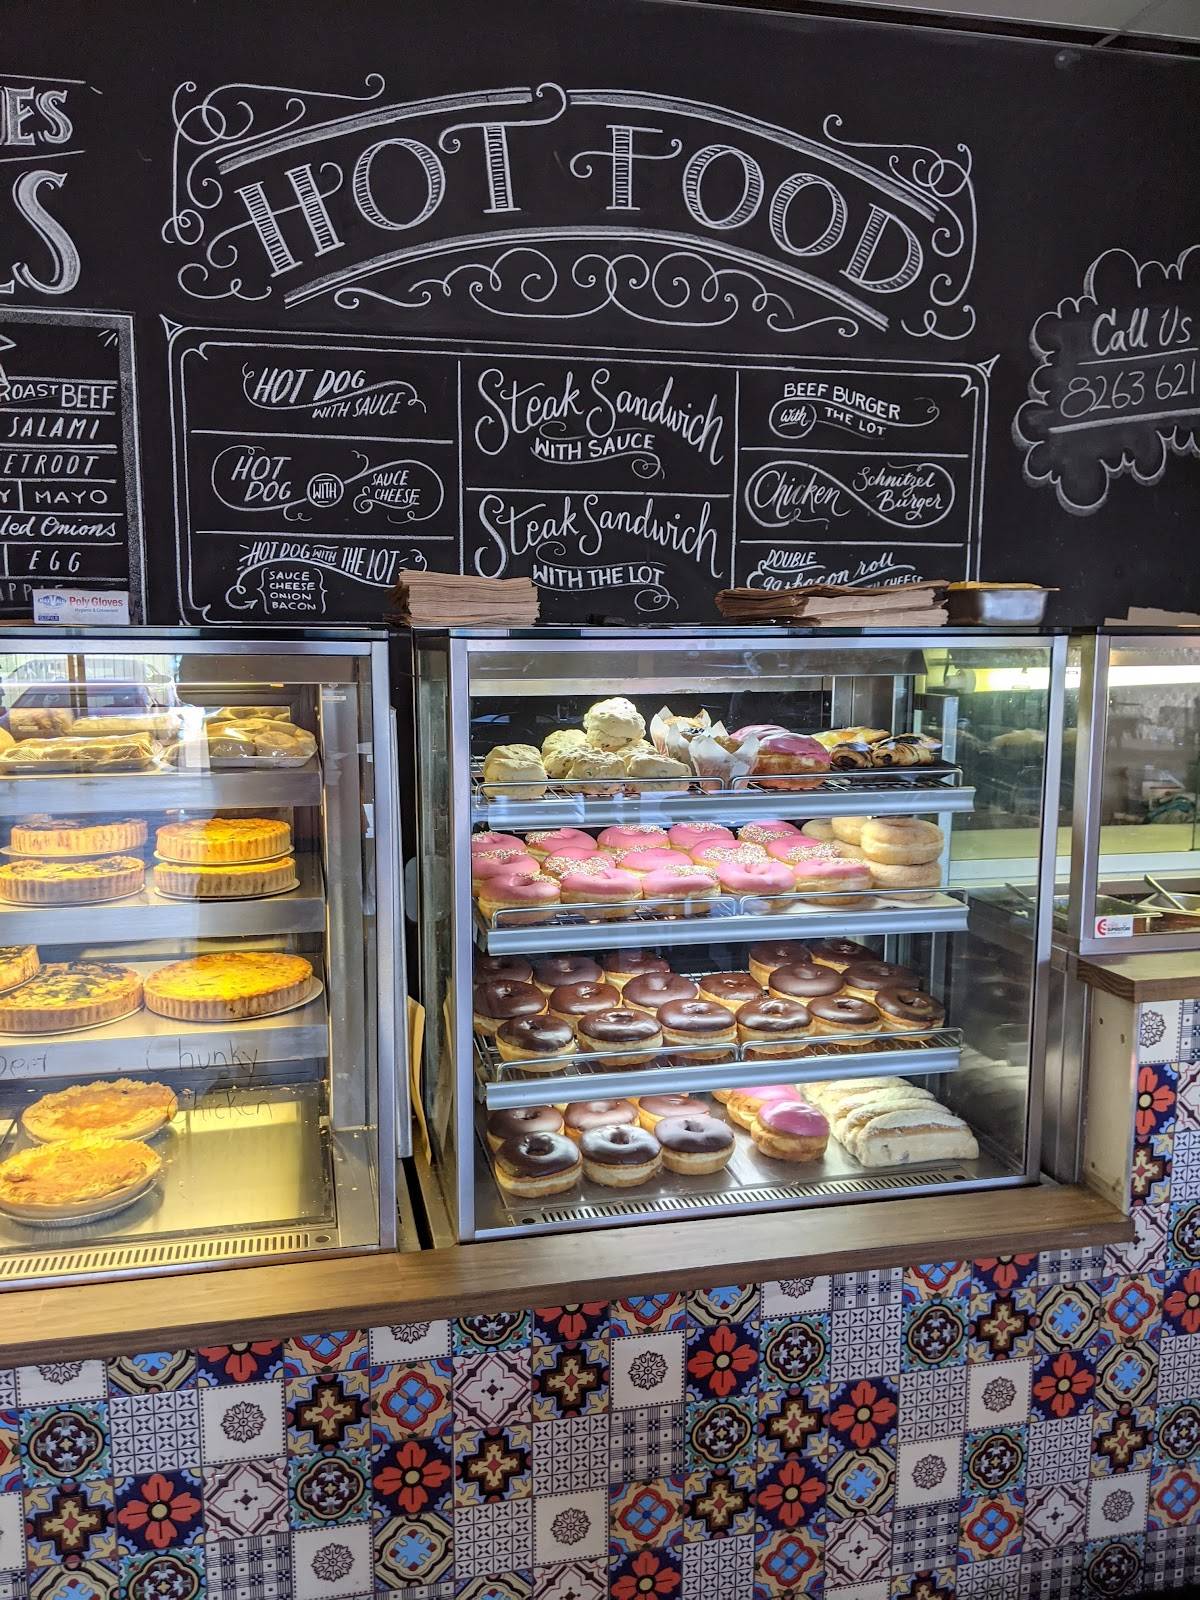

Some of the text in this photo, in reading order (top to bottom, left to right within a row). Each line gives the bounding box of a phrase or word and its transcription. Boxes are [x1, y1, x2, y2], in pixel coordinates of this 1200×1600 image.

[207, 112, 924, 294] HOT FOOD
[0, 169, 81, 296] S
[1092, 306, 1192, 356] Call Us
[61, 384, 117, 409] BEEF
[253, 368, 367, 404] HOT DOG
[1060, 359, 1196, 418] 8263 621
[312, 391, 405, 418] WITH SAUCE
[784, 383, 902, 421] BEEF BURGER
[8, 417, 100, 440] SALAMI
[475, 368, 725, 466] Steak Sandwich
[779, 406, 808, 427] with
[825, 406, 887, 436] THE LOT
[534, 433, 656, 460] WITH SAUCE
[231, 456, 292, 481] HOT
[371, 470, 409, 486] SAUCE
[244, 481, 292, 502] DOG
[312, 482, 337, 499] WITH
[853, 466, 936, 498] Schnitzel
[35, 489, 108, 504] MAYO
[374, 488, 421, 506] CHEESE
[754, 470, 851, 520] Chicken
[876, 490, 944, 521] Burger
[41, 516, 117, 538] Onions
[475, 494, 724, 579] Steak Sandwich
[29, 550, 82, 572] EGG
[249, 541, 401, 584] HOT DOG WITH THE LOT
[766, 549, 818, 569] DOUBLE
[853, 552, 897, 579] roll
[269, 570, 310, 581] SAUCE
[269, 581, 316, 591] CHEESE
[532, 564, 665, 589] WITH THE LOT
[69, 596, 90, 608] Poly
[91, 597, 123, 608] Gloves
[269, 591, 312, 600] ONION
[272, 600, 316, 610] BACON
